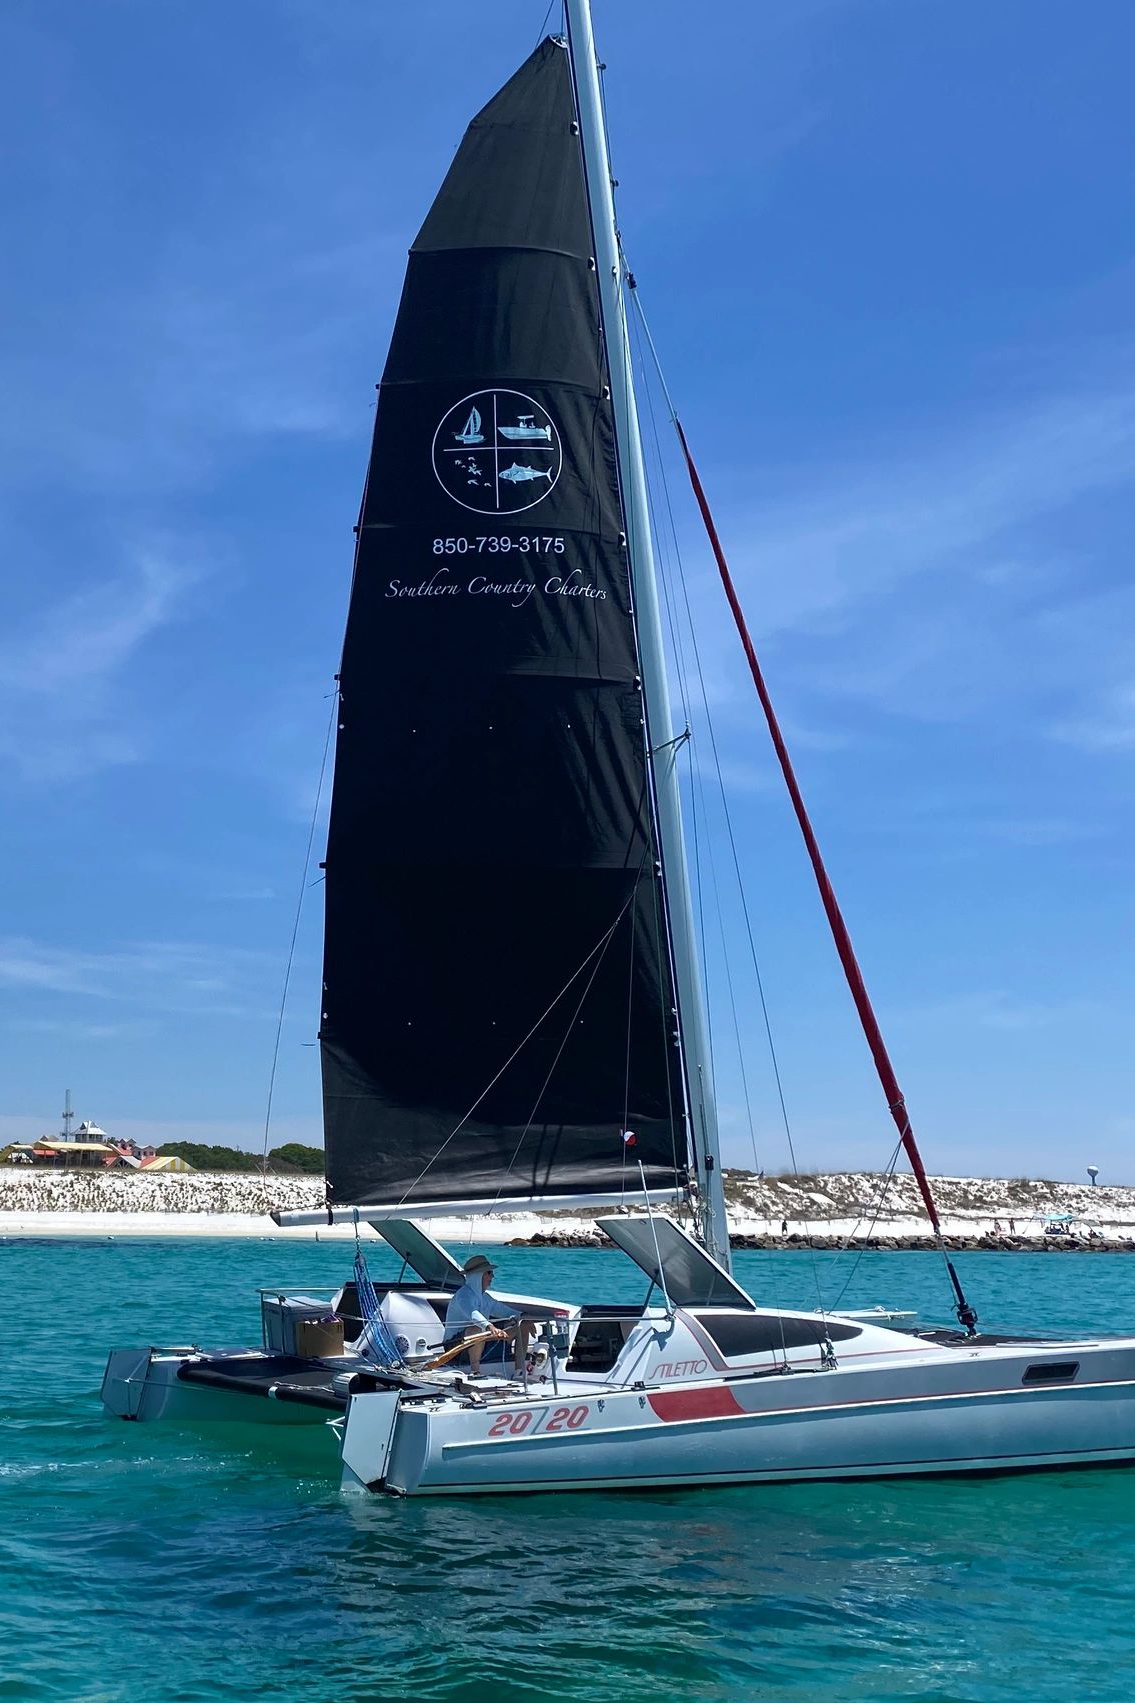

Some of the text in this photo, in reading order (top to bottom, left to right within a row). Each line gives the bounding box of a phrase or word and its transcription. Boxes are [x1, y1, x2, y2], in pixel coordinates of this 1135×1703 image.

[432, 536, 565, 555] 850-739-3175
[384, 567, 607, 608] Southern Country Charters
[648, 1359, 708, 1380] STILETTO
